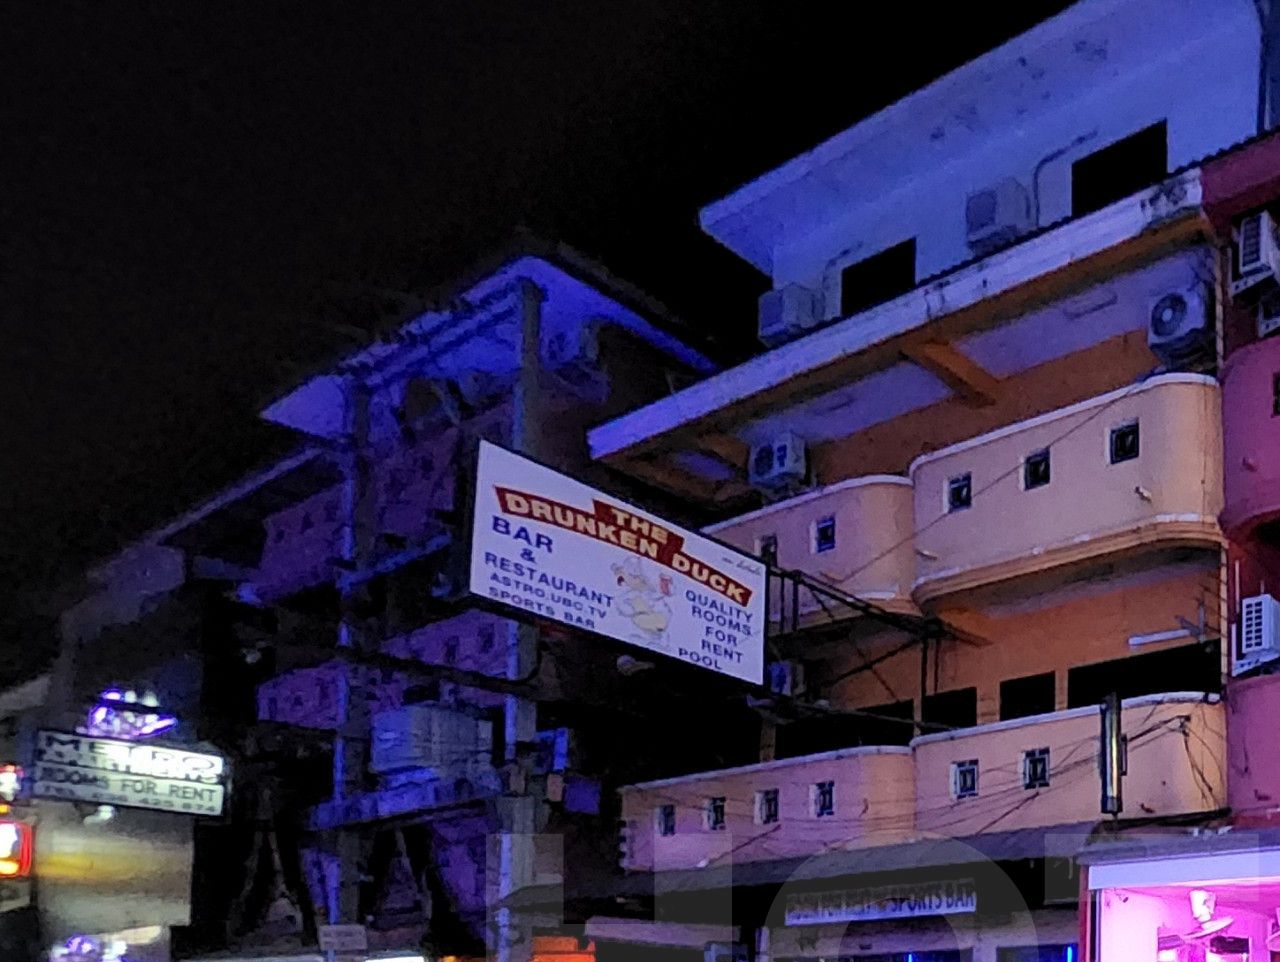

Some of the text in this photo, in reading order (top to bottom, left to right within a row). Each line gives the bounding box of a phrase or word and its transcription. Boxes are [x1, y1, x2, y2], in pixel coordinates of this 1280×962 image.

[491, 515, 554, 554] BAR
[611, 506, 669, 545] THE
[503, 493, 749, 605] DRUNKEN DUCK
[520, 547, 537, 564] &
[484, 551, 615, 609] RESTAURANT
[490, 571, 546, 600] ASTRO
[586, 602, 608, 621] TV
[488, 586, 596, 630] SPORTS BAR
[685, 589, 754, 624] QUALITY
[691, 606, 753, 637] ROOMS
[700, 638, 745, 665] RENT
[704, 625, 739, 647] FOR
[677, 647, 723, 671] POOL
[121, 778, 159, 796] FOR
[168, 783, 217, 801] RENT
